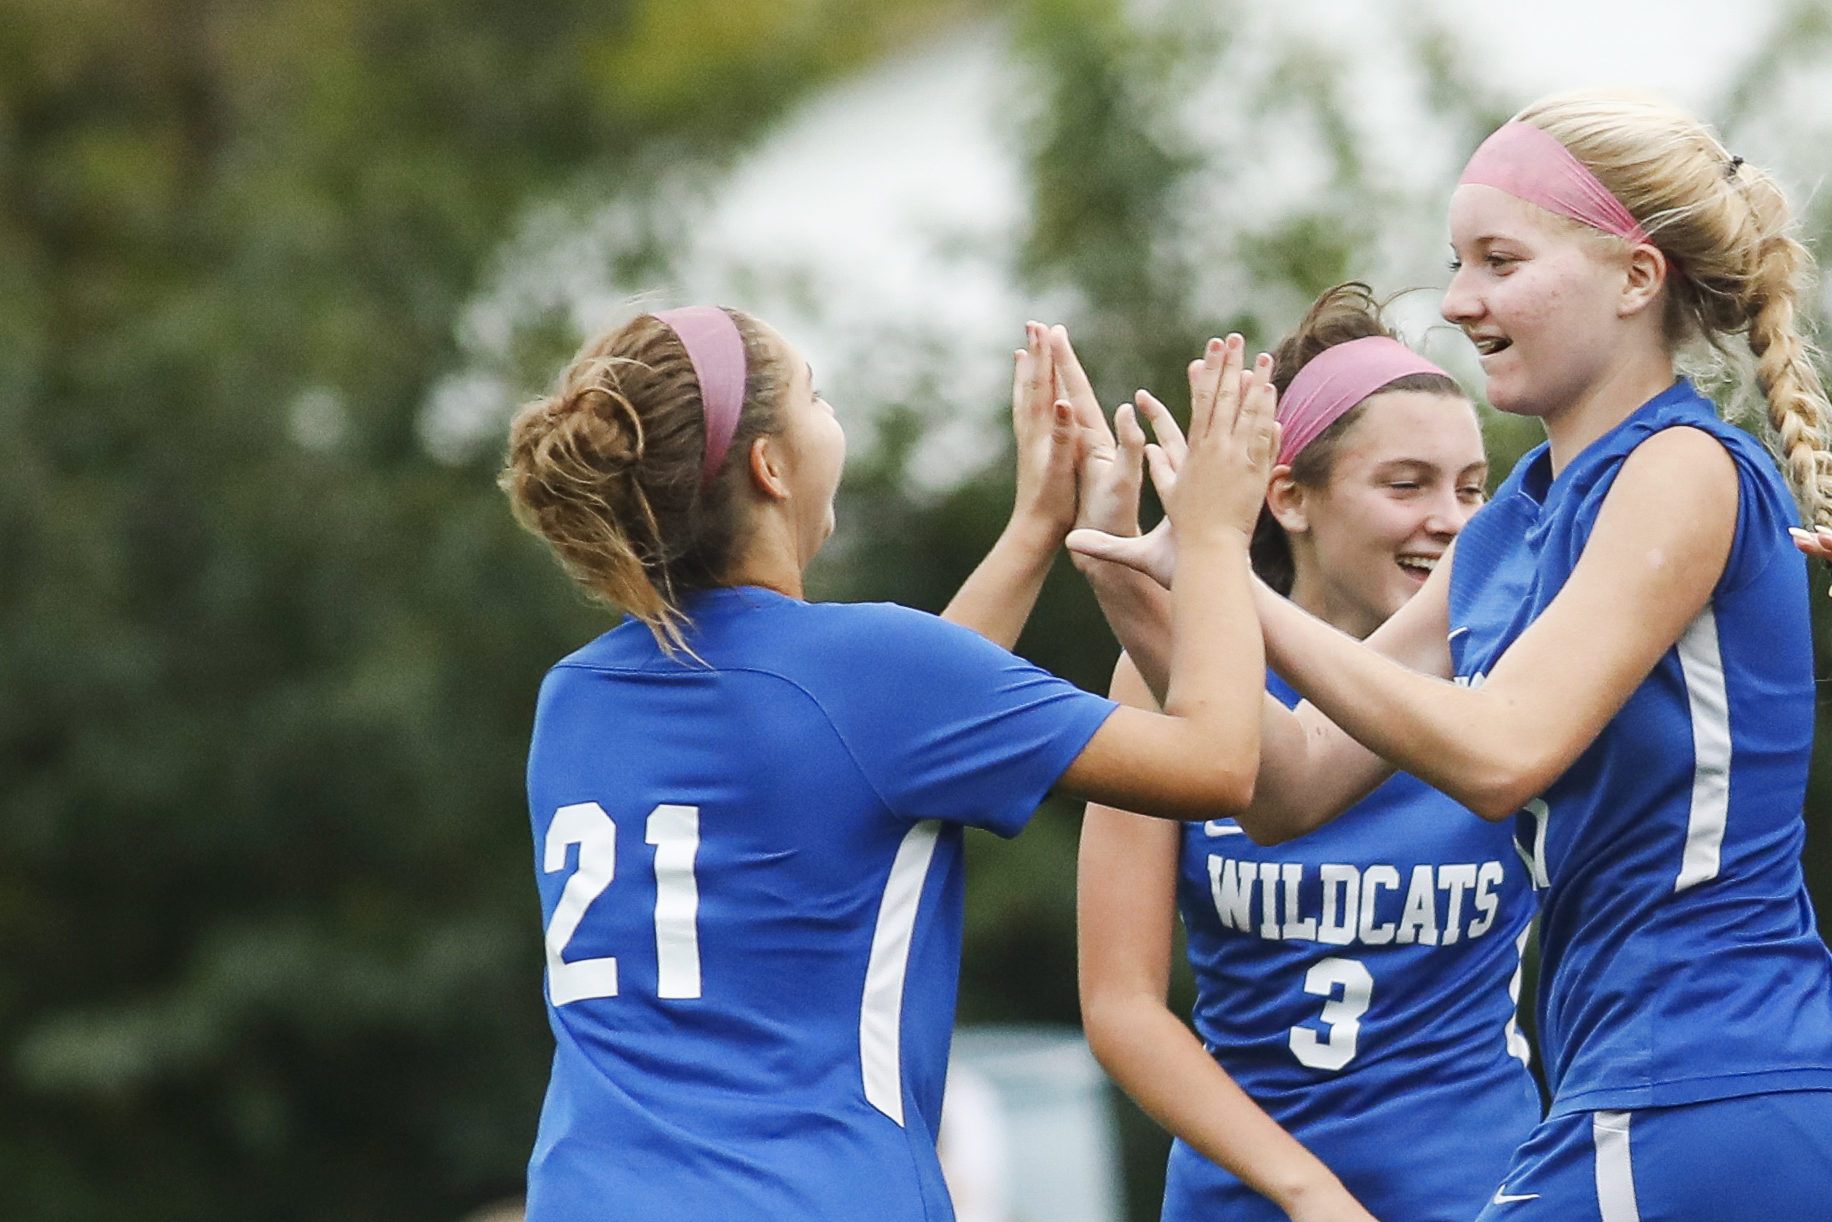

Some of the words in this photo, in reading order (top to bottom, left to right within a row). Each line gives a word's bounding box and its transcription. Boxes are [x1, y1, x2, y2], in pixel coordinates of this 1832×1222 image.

[543, 801, 701, 1007] 21
[1207, 854, 1504, 946] WILDCATS
[1289, 956, 1374, 1071] 3
